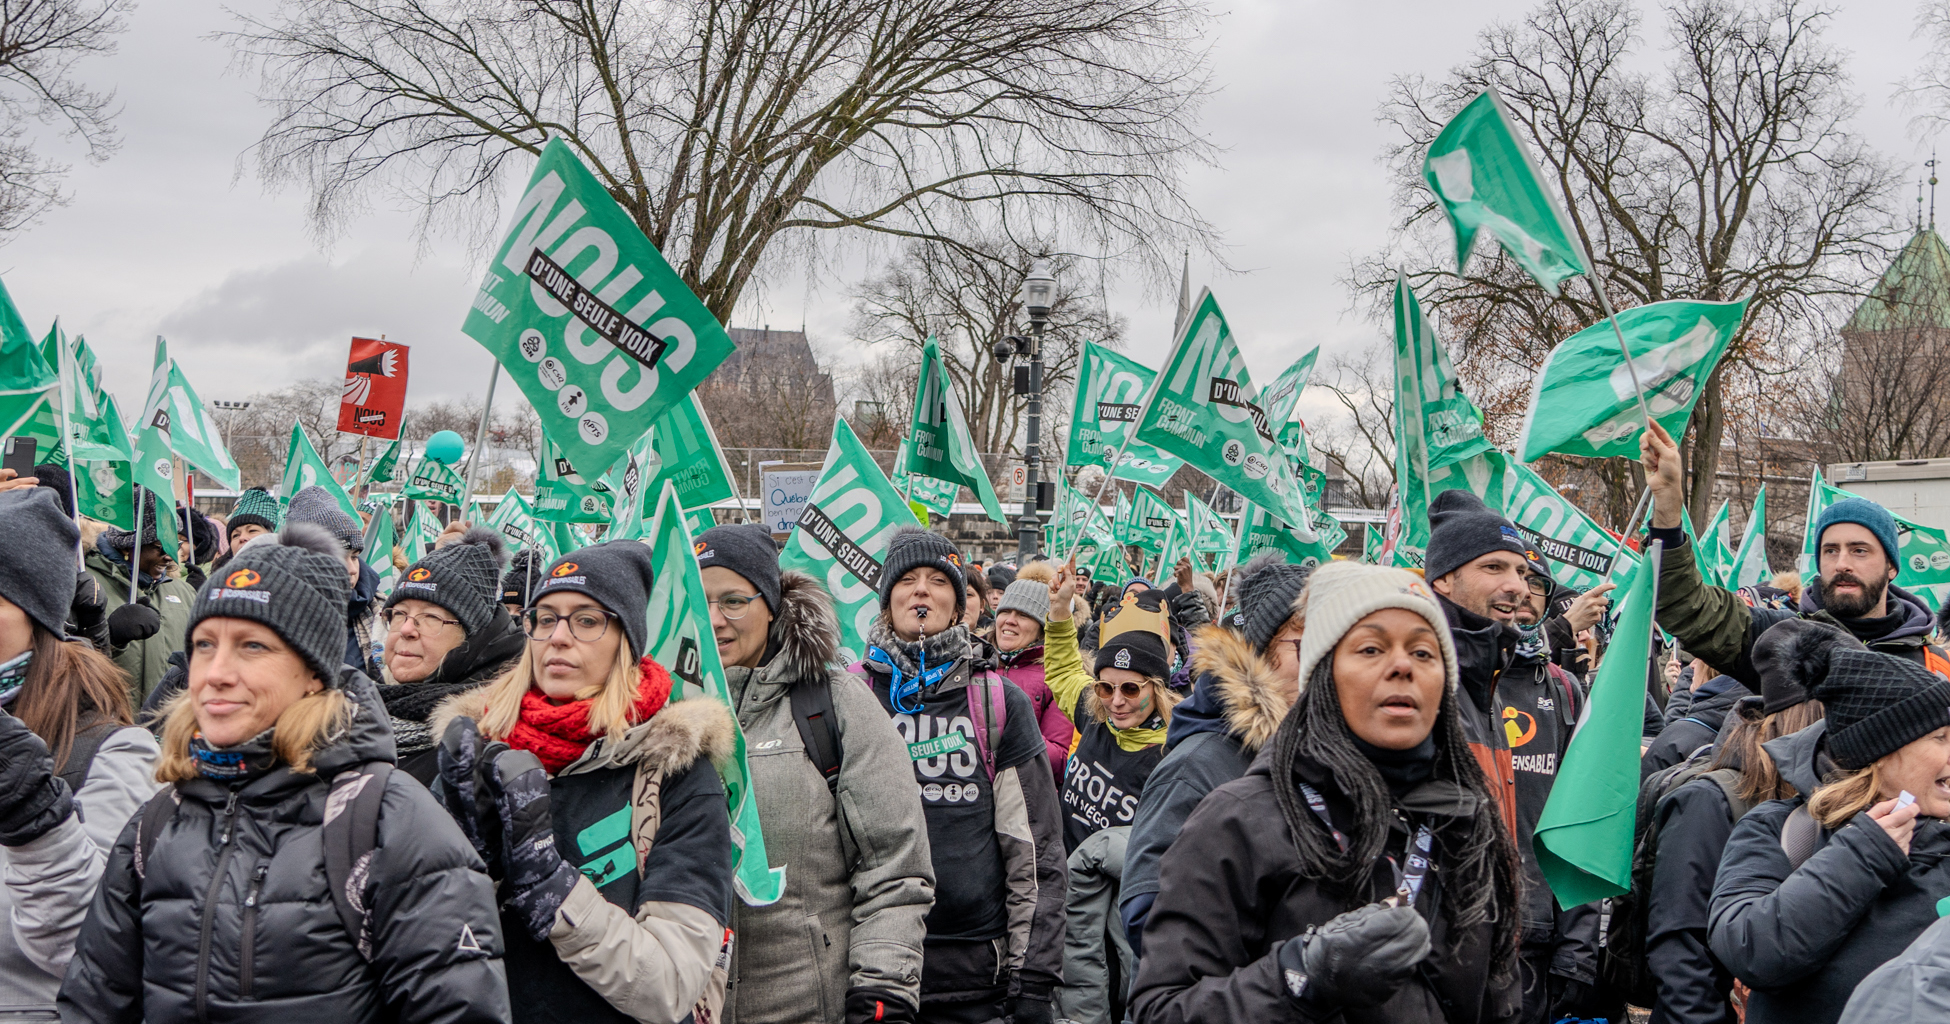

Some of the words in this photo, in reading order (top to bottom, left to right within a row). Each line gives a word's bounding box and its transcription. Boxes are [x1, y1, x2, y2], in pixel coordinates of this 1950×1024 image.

[502, 170, 696, 411] NOUS
[530, 255, 576, 302] D'UNE
[573, 291, 619, 335] SEULE
[617, 324, 659, 362] VOIX
[522, 342, 534, 358] CSN
[552, 368, 564, 384] CSQ
[353, 407, 386, 426] NOUS
[1157, 398, 1197, 423] FRONT
[583, 418, 602, 438] APTS
[915, 429, 936, 443] FRONT
[1078, 428, 1101, 442] FRON
[1156, 415, 1207, 449] COMMUN
[1225, 454, 1237, 463] CSN
[1255, 460, 1268, 471] CSQ
[768, 474, 780, 488] Si
[770, 488, 808, 507] Québe
[504, 525, 523, 538] D'UNE
[1147, 519, 1163, 527] D'UNE
[801, 508, 841, 550] D'UNE
[837, 542, 879, 583] SEULE
[1249, 532, 1277, 547] FRONT
[1540, 539, 1577, 562] SEULE
[1578, 550, 1608, 572] VOIX
[1114, 661, 1130, 669] CSN
[891, 713, 978, 778] OUS
[910, 741, 941, 758] SEULE
[941, 734, 963, 750] VOIX
[1511, 752, 1556, 776] ENSABLES
[1066, 755, 1139, 823] PROFS
[1064, 788, 1079, 809] EN
[1080, 799, 1110, 830] NÉGO
